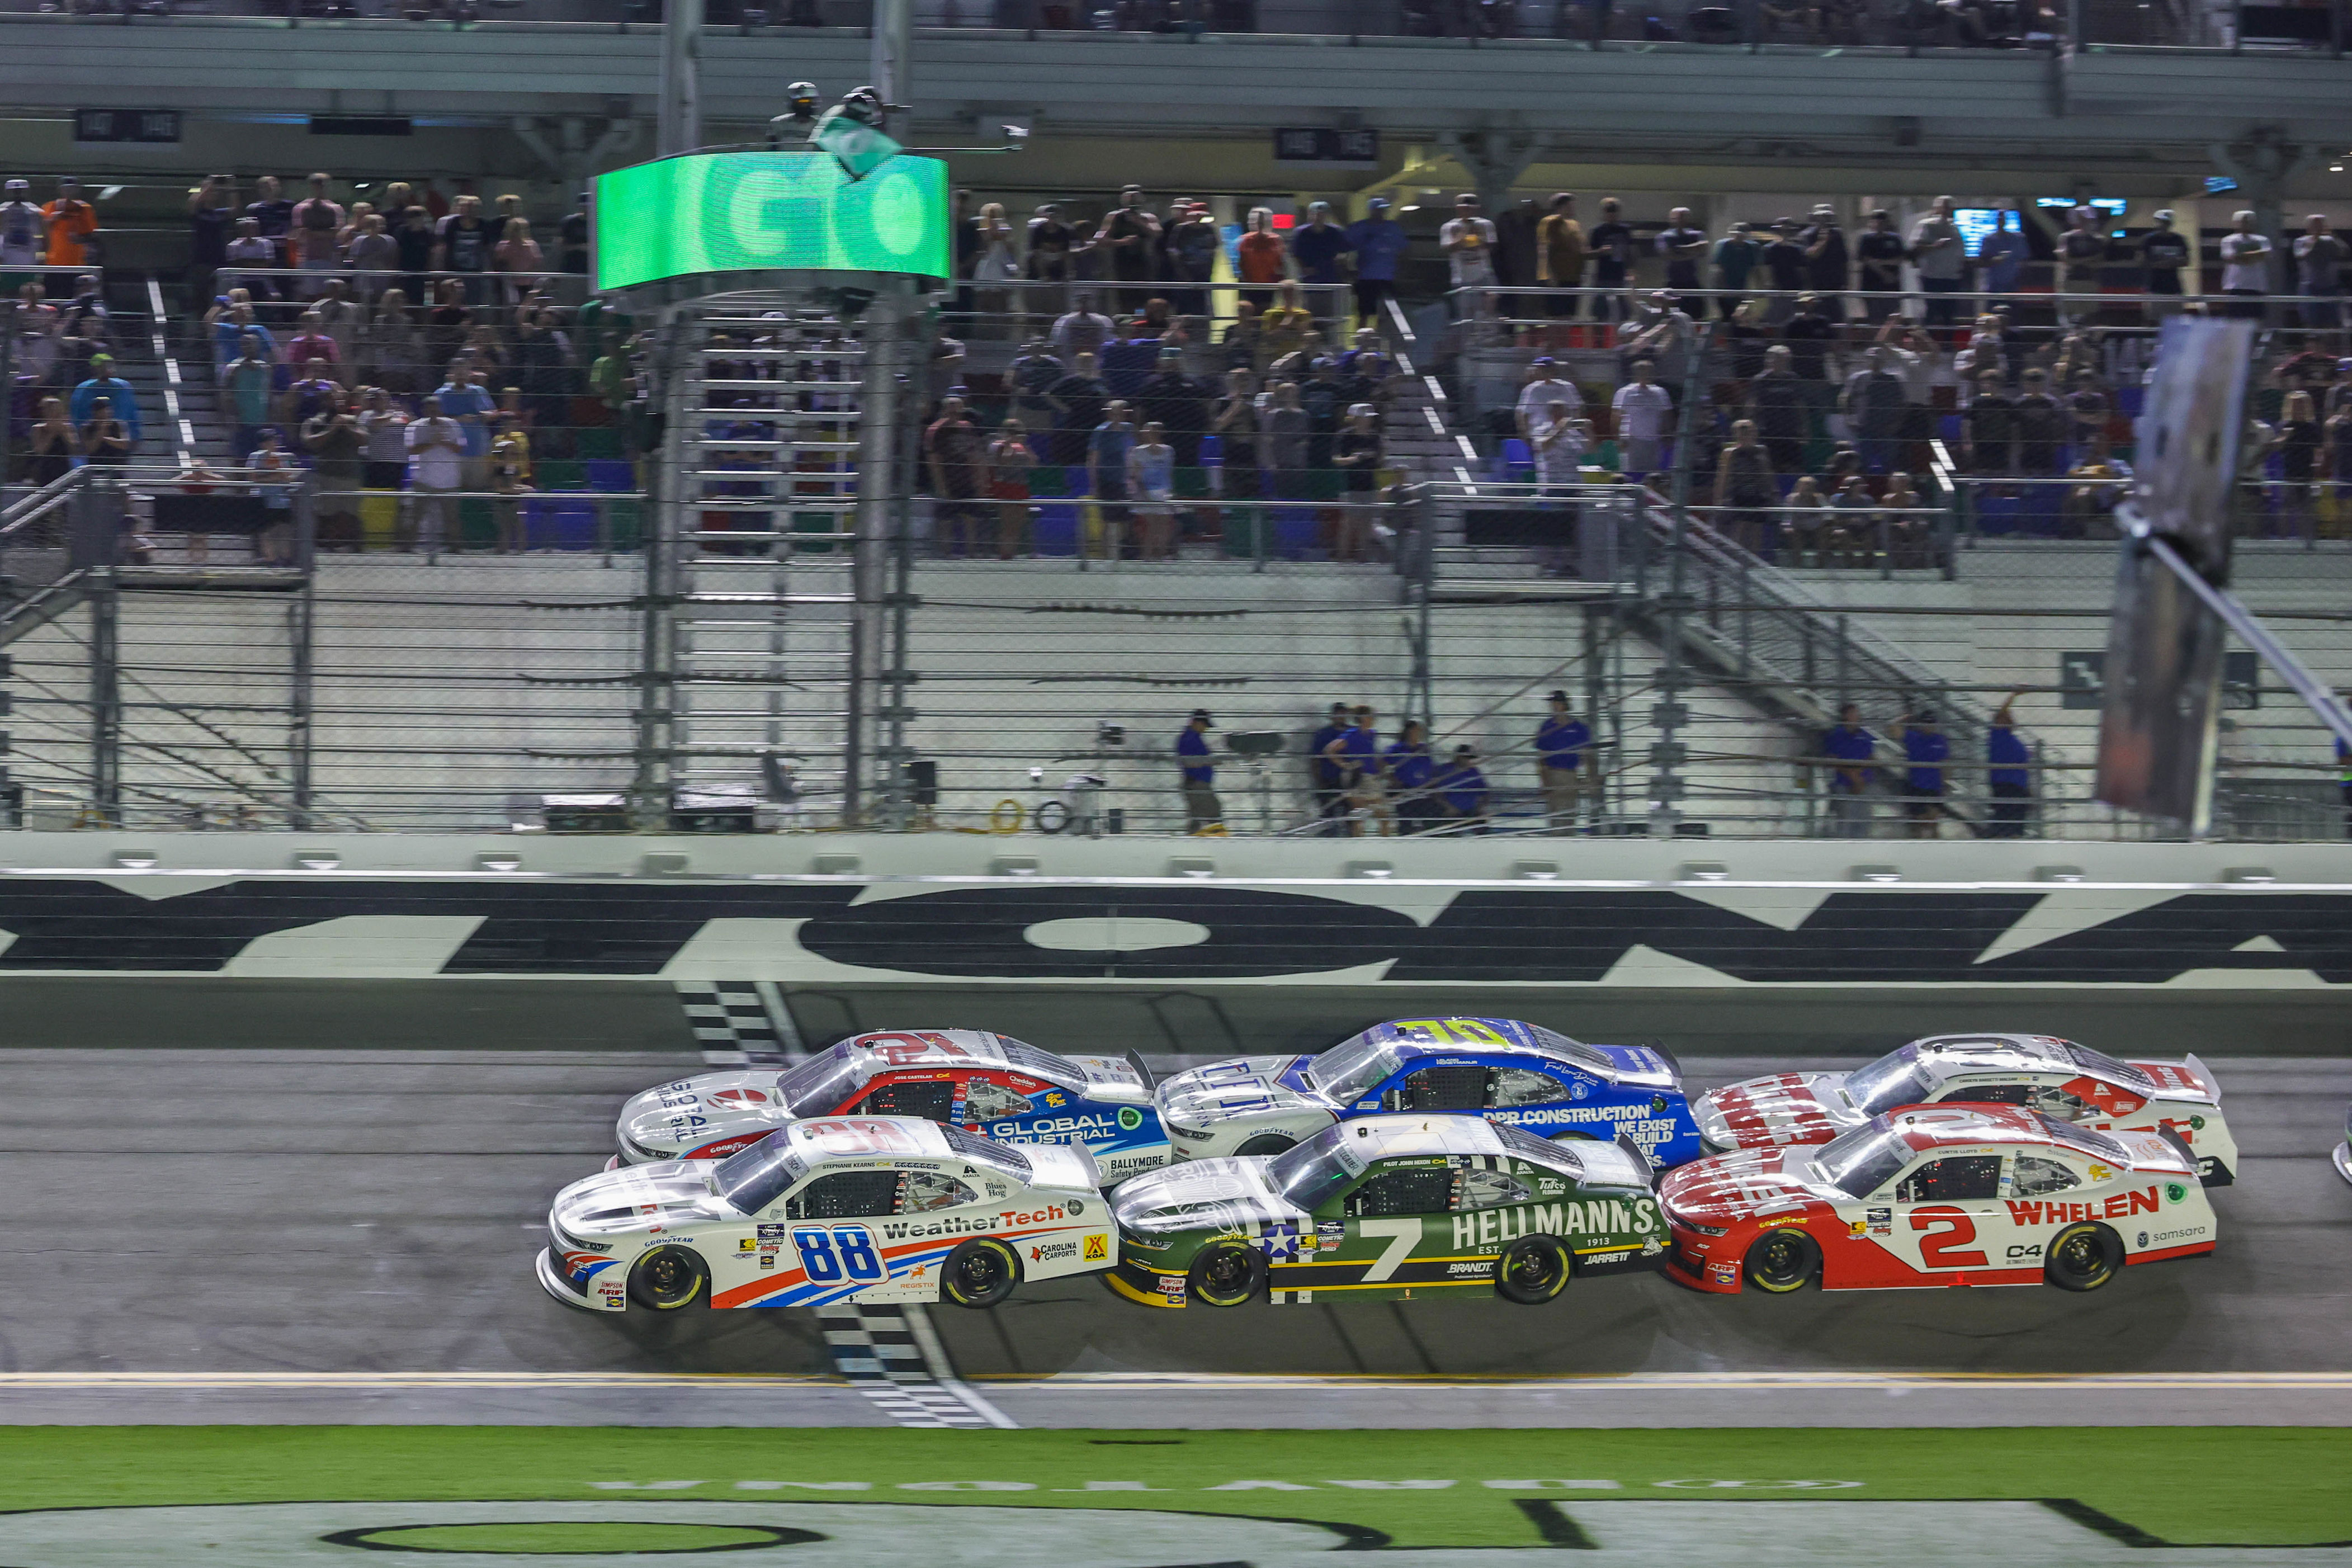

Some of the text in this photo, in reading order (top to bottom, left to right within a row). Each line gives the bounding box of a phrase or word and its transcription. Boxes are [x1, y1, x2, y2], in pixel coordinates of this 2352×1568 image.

[713, 159, 937, 266] GO
[854, 1033, 980, 1066] 21
[1483, 1104, 1651, 1125] DPR CONSTRUCTION
[993, 1114, 1116, 1137] GLOBAL
[1250, 1127, 1294, 1136] GOODYEAR
[1614, 1118, 1676, 1133] WE EXIST
[994, 1128, 1116, 1145] INDUSTRIAL
[1632, 1131, 1674, 1144] BUILD
[710, 1142, 748, 1153] GOODYE
[1111, 1155, 1164, 1169] BALLYMORE
[1111, 1169, 1132, 1178] Safety
[1538, 1178, 1566, 1190] Tufco
[989, 1189, 1006, 1198] Hog
[2004, 1186, 2159, 1226] WHELEN
[883, 1205, 1064, 1240] WeatherTech
[645, 1235, 693, 1247] GOODYEAR
[1205, 1232, 1254, 1244] GOODYEAR
[1910, 1206, 1990, 1268] 2
[2153, 1226, 2205, 1242] samsara
[1041, 1242, 1077, 1254] CAROLINA
[1586, 1237, 1610, 1246] 1913
[792, 1225, 884, 1282] 88
[1045, 1250, 1077, 1261] CARPORTS
[1359, 1218, 1422, 1282] 7
[2006, 1244, 2043, 1258] C4
[1584, 1251, 1631, 1265] JARRETT
[1447, 1262, 1494, 1274] BRANDT
[1709, 1263, 1736, 1272] ARP
